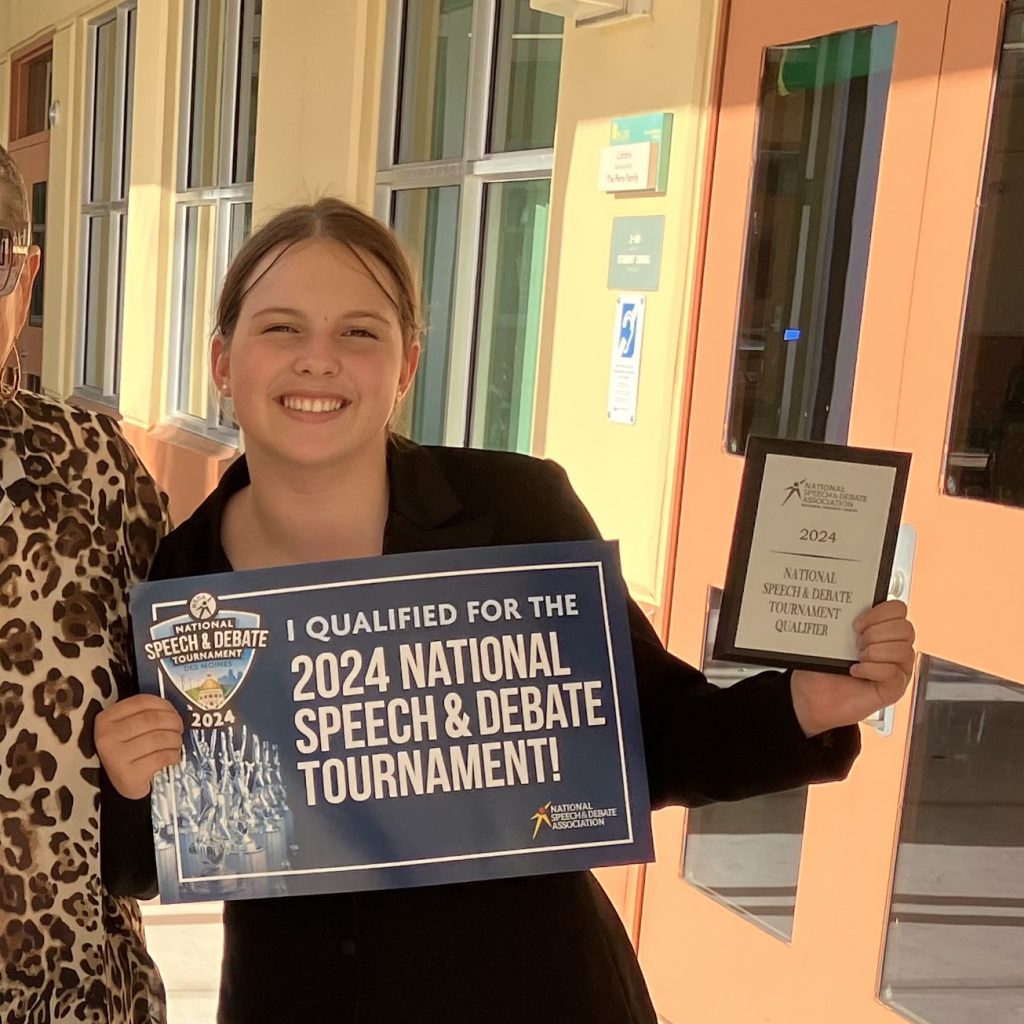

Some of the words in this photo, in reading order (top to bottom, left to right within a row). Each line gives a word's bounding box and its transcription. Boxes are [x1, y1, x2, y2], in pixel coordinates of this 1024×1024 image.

[804, 482, 845, 492] NATIONAL
[803, 497, 854, 507] ASSOCIATION
[840, 494, 868, 502] DEBATE
[800, 528, 836, 543] 2024
[784, 568, 837, 584] NATIONAL
[762, 583, 800, 598] SPEECH
[802, 586, 809, 598] &
[812, 589, 852, 604] DEBATE
[769, 600, 841, 620] TOURNAMENT
[286, 619, 295, 642] I
[305, 604, 457, 641] QUALIFIED
[467, 598, 522, 624] FOR
[528, 594, 579, 619] THE
[176, 620, 234, 634] NATIONAL
[775, 619, 828, 636] QUALIFIER
[144, 634, 198, 660] SPEECH
[202, 632, 211, 650] &
[214, 630, 269, 648] DEBATE
[172, 649, 242, 664] TOURNAMENT
[184, 664, 198, 672] DES
[200, 660, 232, 669] MOINES
[291, 646, 390, 701] 2024
[400, 632, 571, 690] NATIONAL
[191, 709, 236, 727] 2024
[294, 694, 437, 754] SPEECH
[444, 694, 470, 738] &
[478, 680, 606, 736] DEBATE
[297, 737, 562, 806] TOURNAMENT!
[550, 802, 593, 813] NATIONAL
[550, 812, 581, 822] SPEECH
[588, 808, 618, 817] DEBATE
[552, 818, 605, 830] ASSOCIATION
